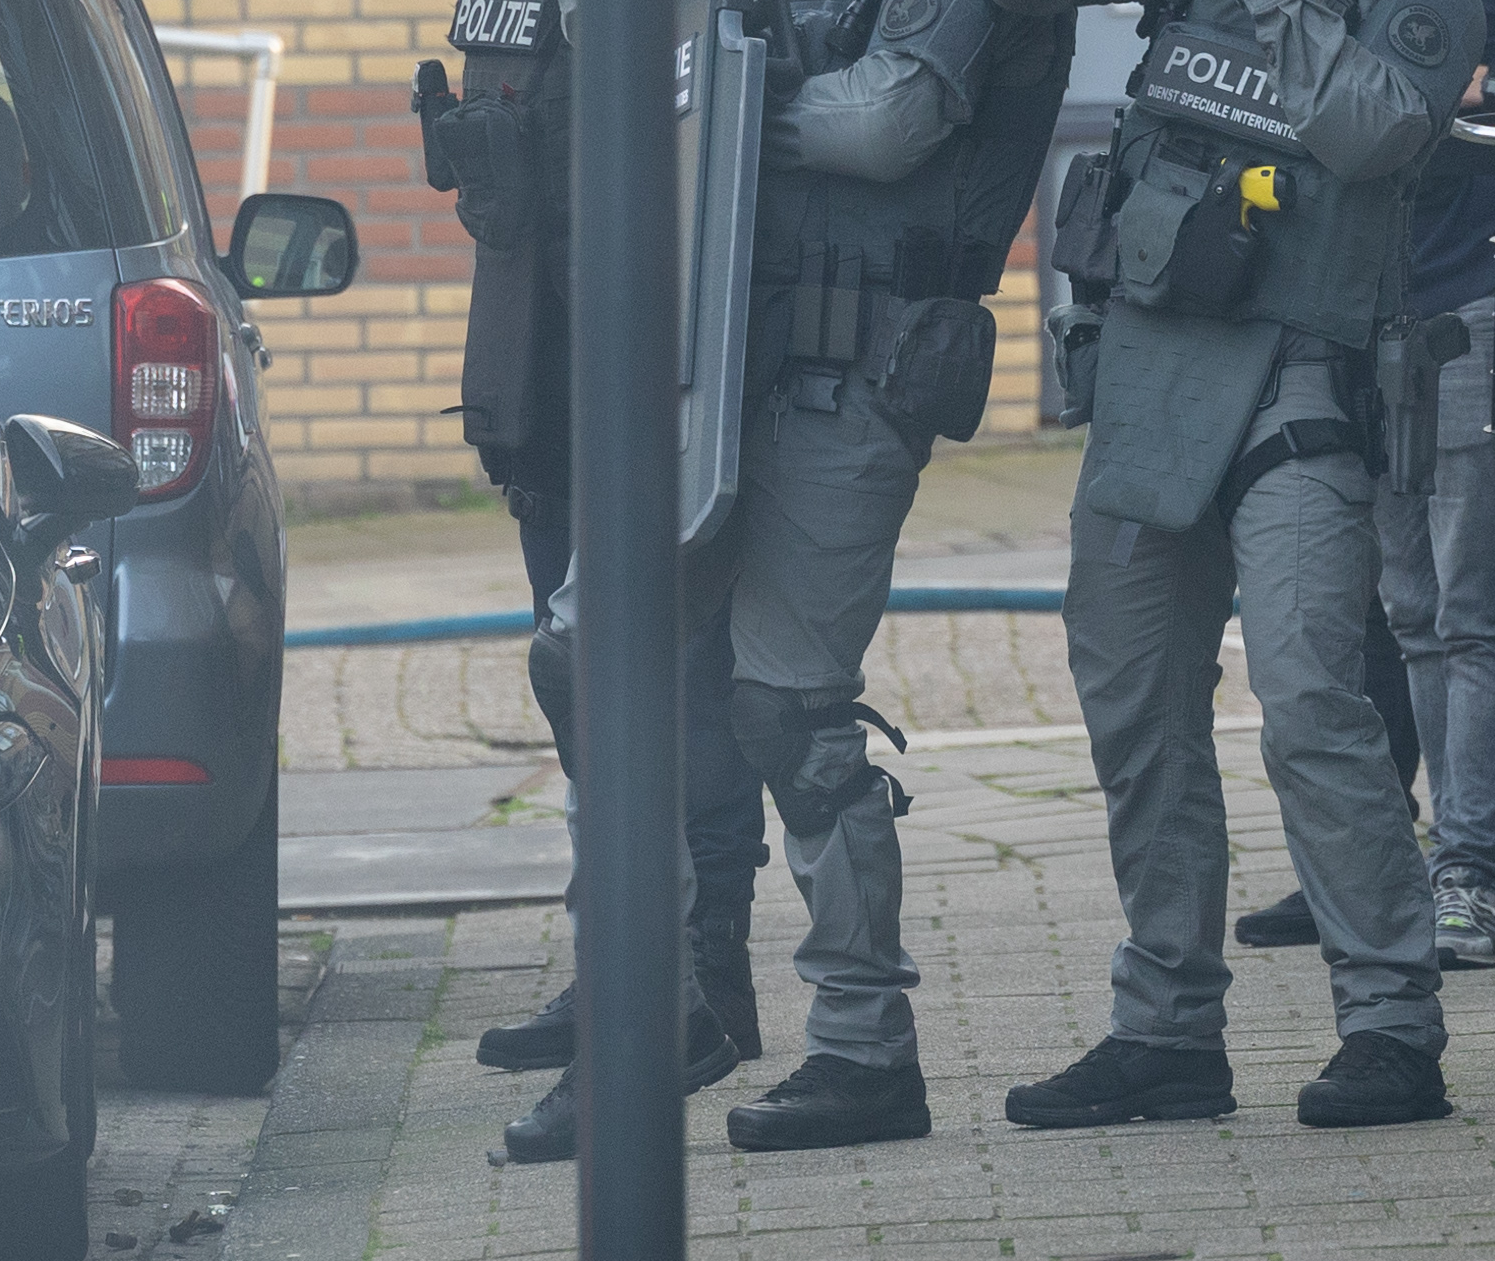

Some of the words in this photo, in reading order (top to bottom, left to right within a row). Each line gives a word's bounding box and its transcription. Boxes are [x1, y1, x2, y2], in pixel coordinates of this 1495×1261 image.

[1163, 45, 1283, 108] POLIT
[1147, 83, 1181, 104] DIENST
[1179, 91, 1230, 119] SPECIALE
[1229, 107, 1301, 143] INTERVENTI
